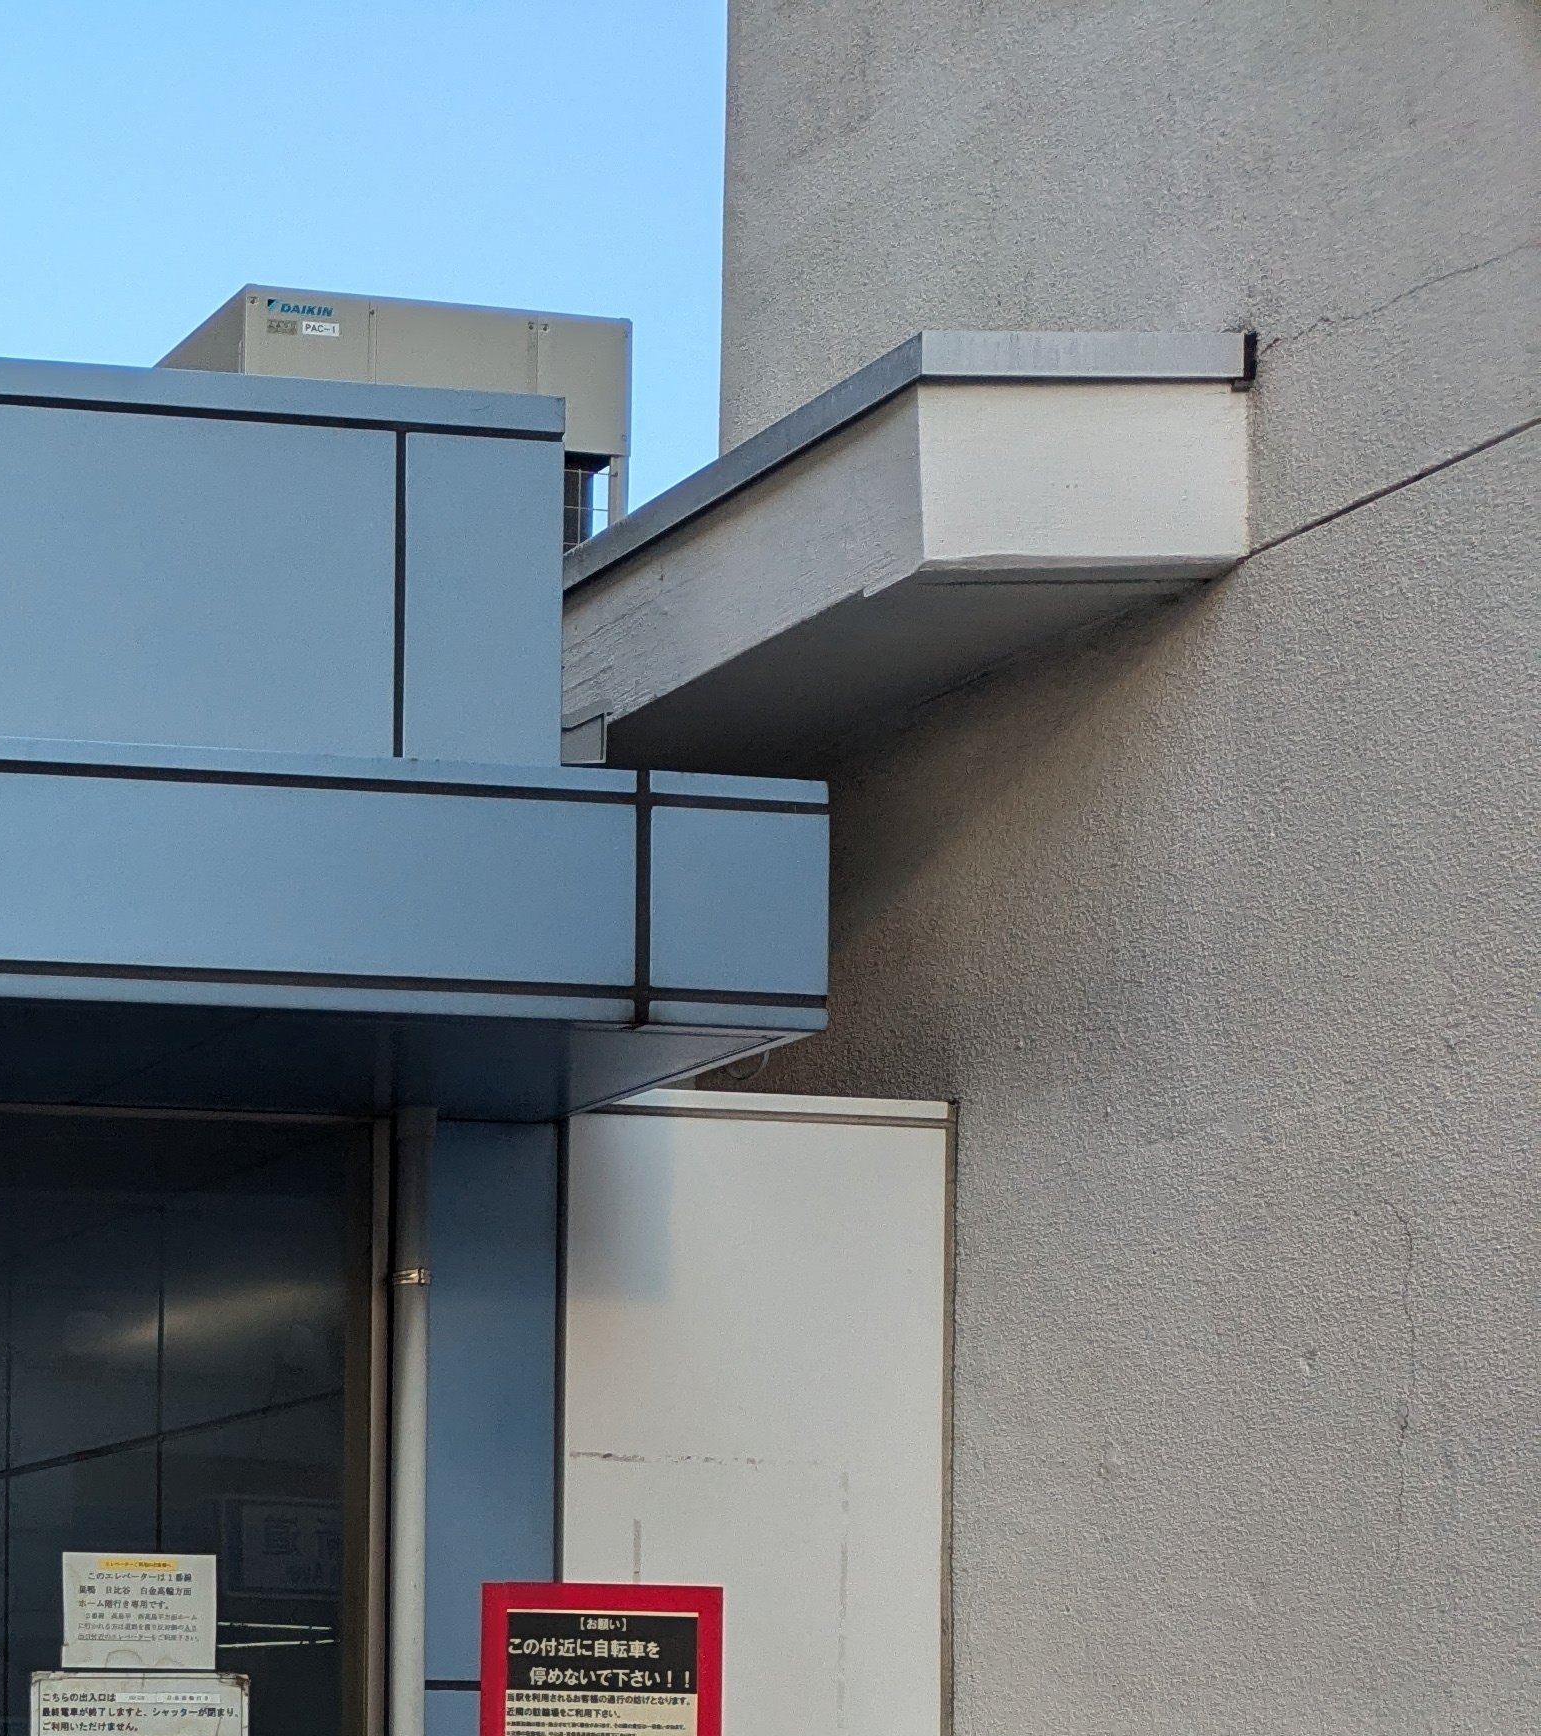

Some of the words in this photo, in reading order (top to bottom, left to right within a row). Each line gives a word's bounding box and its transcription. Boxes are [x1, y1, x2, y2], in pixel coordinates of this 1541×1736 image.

[280, 303, 334, 317] DAIKIN
[580, 1617, 627, 1631] 【お願い】
[507, 1637, 660, 1659] この付近に自転車を
[529, 1666, 690, 1688] 停めないで下さい！！
[42, 1692, 116, 1703] こちらの出入口は
[42, 1707, 239, 1718] 最終電車が終了しますと、シャッターが閉まり、
[42, 1722, 139, 1732] ご利用いただけません。
